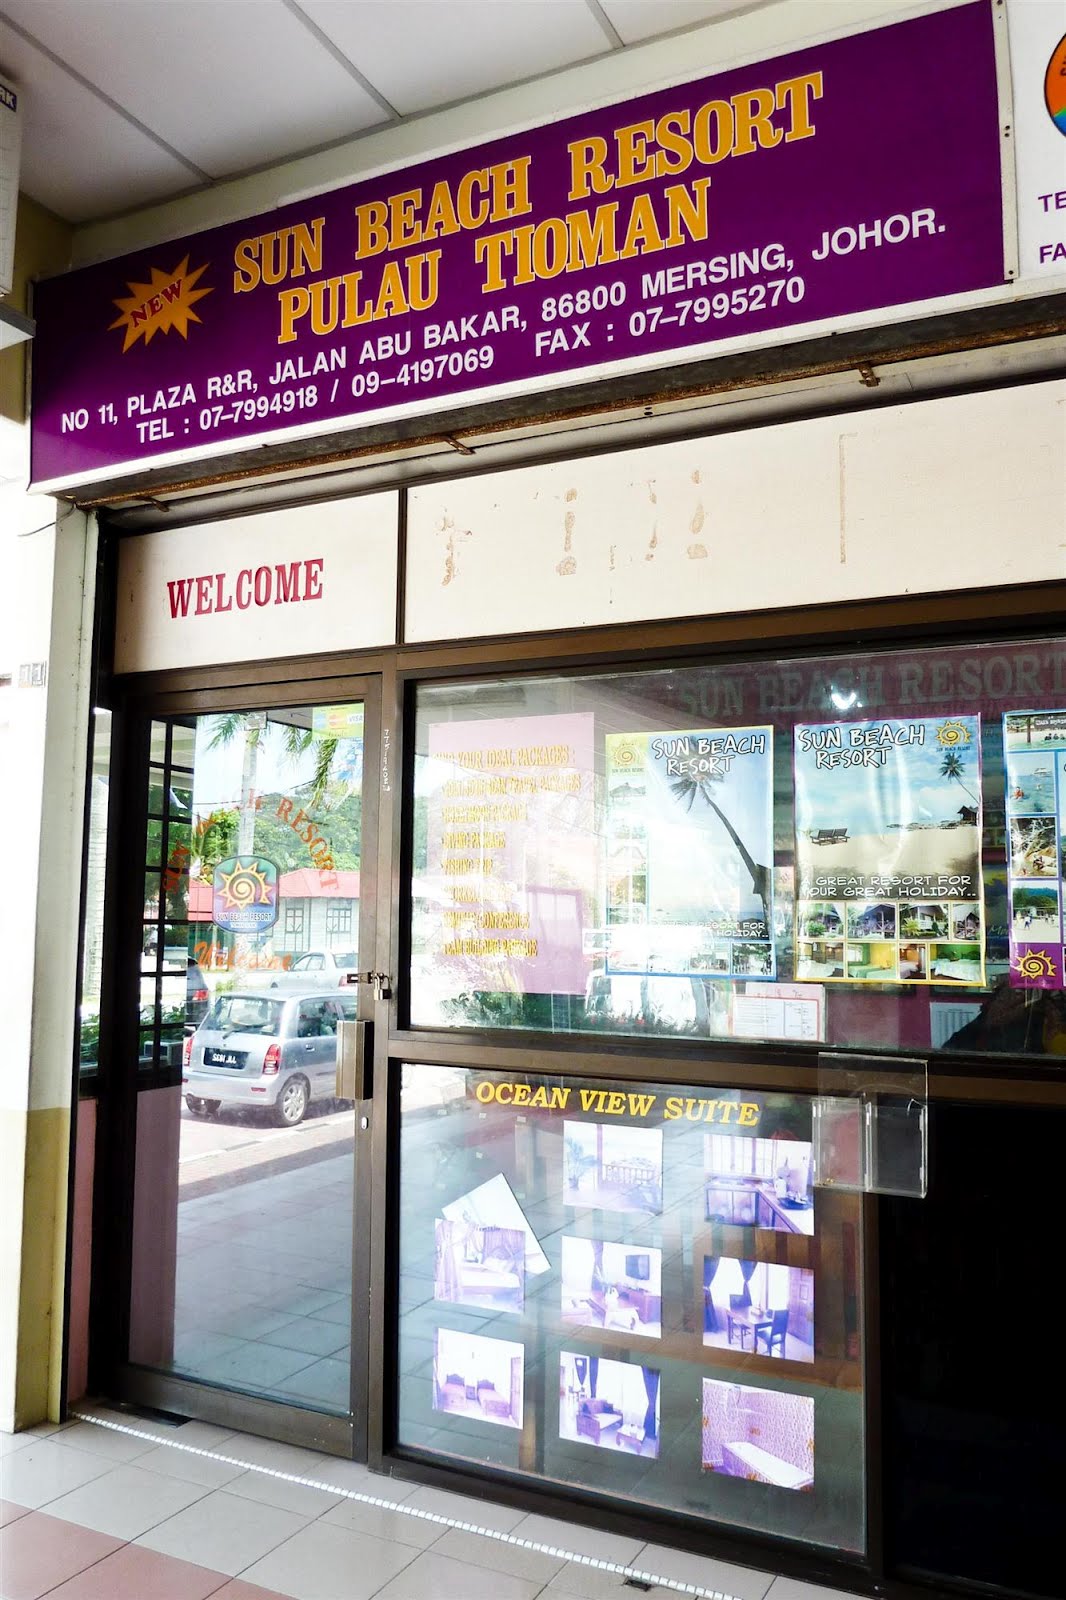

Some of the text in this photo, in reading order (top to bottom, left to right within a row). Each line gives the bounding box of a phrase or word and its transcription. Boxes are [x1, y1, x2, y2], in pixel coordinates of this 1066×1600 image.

[233, 71, 824, 293] SUN BEACH RESORT
[278, 178, 712, 345] PULAU TIOMAN
[61, 208, 946, 433] NO 11, PLAZA R&R, JALAN ABU BAKAR, 86800 MERSING, JOHOR.
[130, 278, 185, 329] NEW
[136, 419, 174, 445] TEL
[199, 389, 318, 431] 07-7994918
[351, 345, 494, 399] 09-4197069
[534, 320, 591, 357] FAX
[629, 276, 805, 338] 07-7995270
[167, 558, 324, 618] WELCOME
[679, 676, 743, 718] SUN
[898, 648, 1066, 704] RESORT
[652, 733, 765, 759] SUN BEACH
[798, 724, 925, 752] SUN BEACH
[458, 751, 482, 768] YOUR
[487, 749, 514, 768] IDEAL
[517, 745, 569, 766] PACKAGES
[666, 754, 736, 776] RESORT
[815, 746, 892, 770] RESORT
[275, 797, 339, 890] RESORT
[815, 876, 865, 886] GREAT
[870, 876, 932, 886] RESORT
[937, 875, 971, 885] FOR
[843, 887, 893, 897] GREAT
[250, 912, 272, 921] RESORT
[743, 922, 765, 930] FOR
[475, 1081, 761, 1126] OCEAN VIEW SUITE
